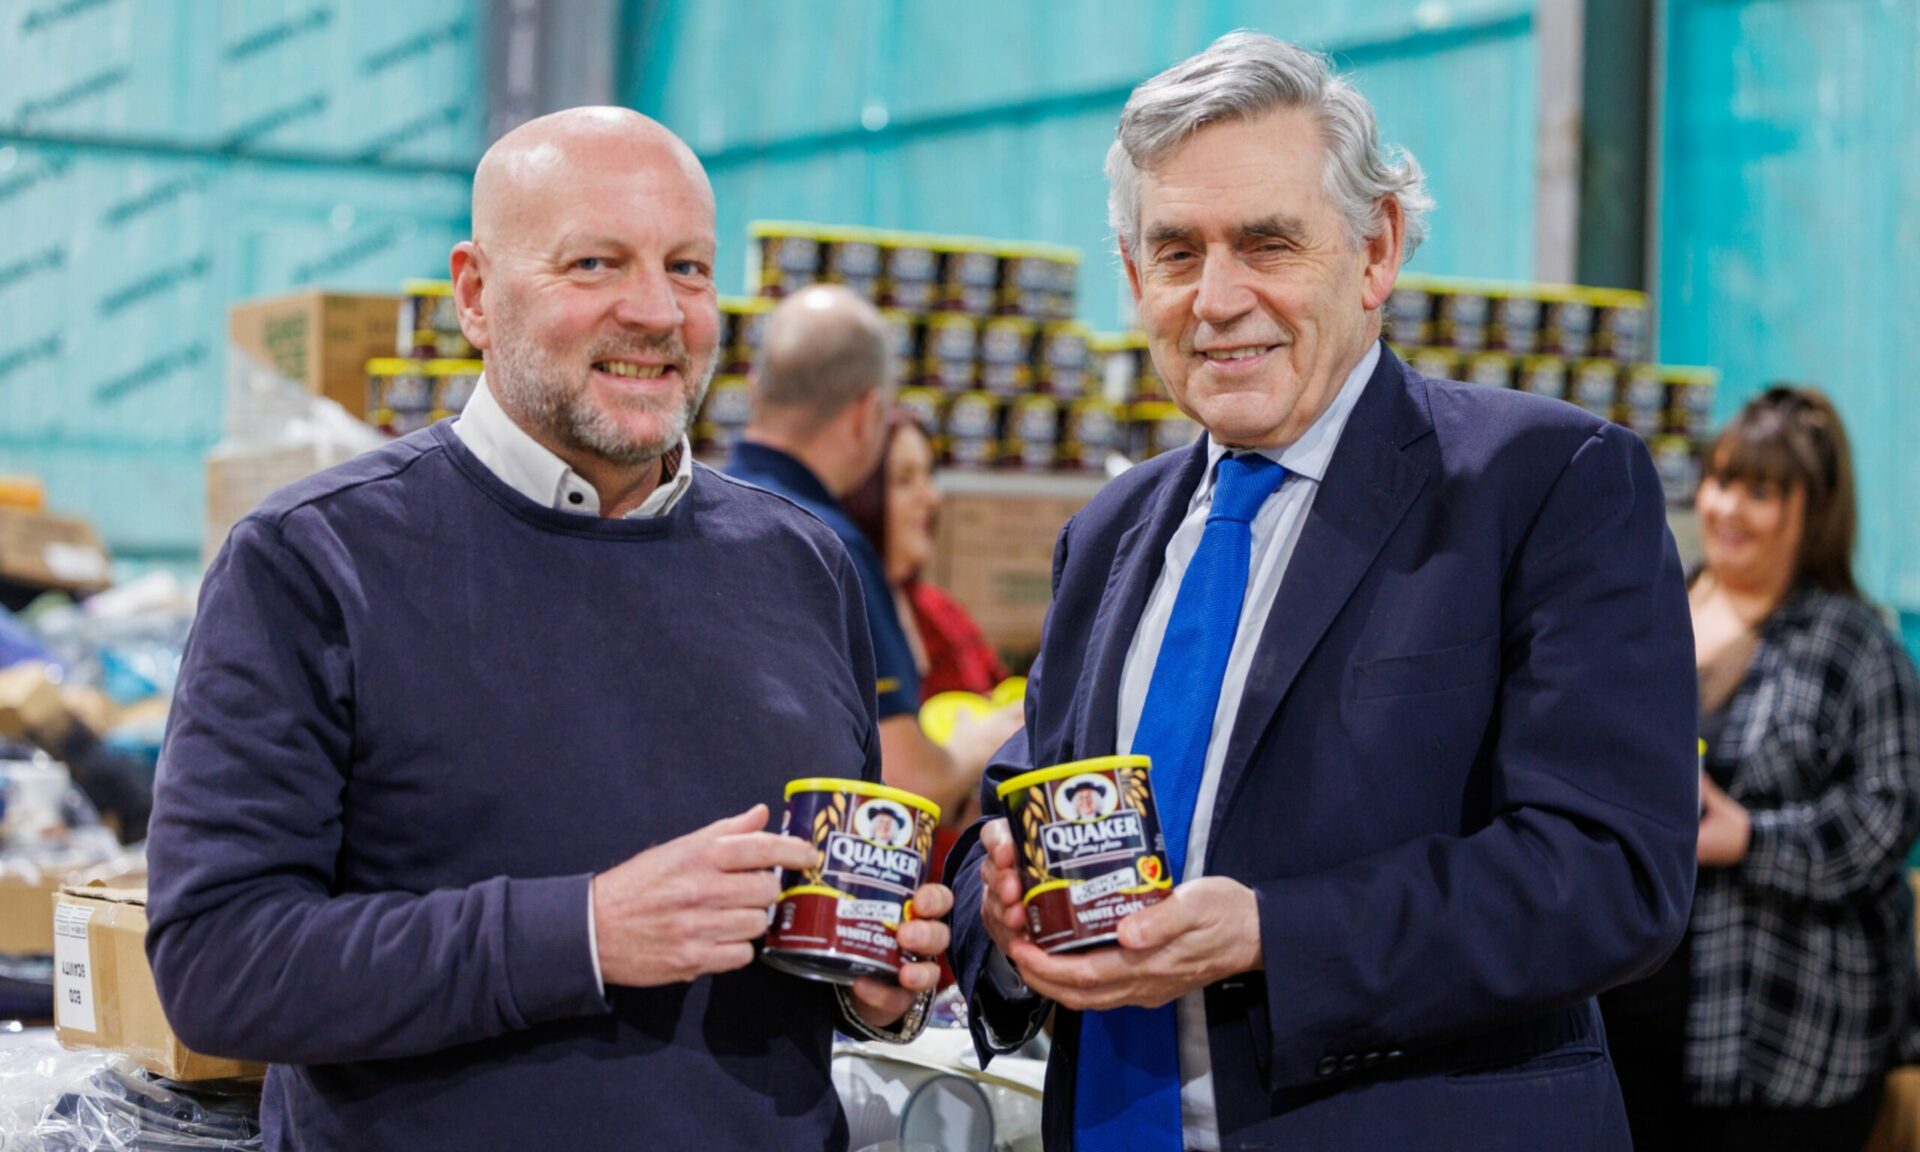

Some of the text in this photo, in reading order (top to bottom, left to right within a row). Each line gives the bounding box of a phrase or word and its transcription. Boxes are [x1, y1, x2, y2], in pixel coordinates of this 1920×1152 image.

[1045, 816, 1139, 853] QUAKER
[831, 837, 917, 878] QUAKER
[1076, 905, 1115, 923] WHITE
[836, 924, 872, 943] WHITE
